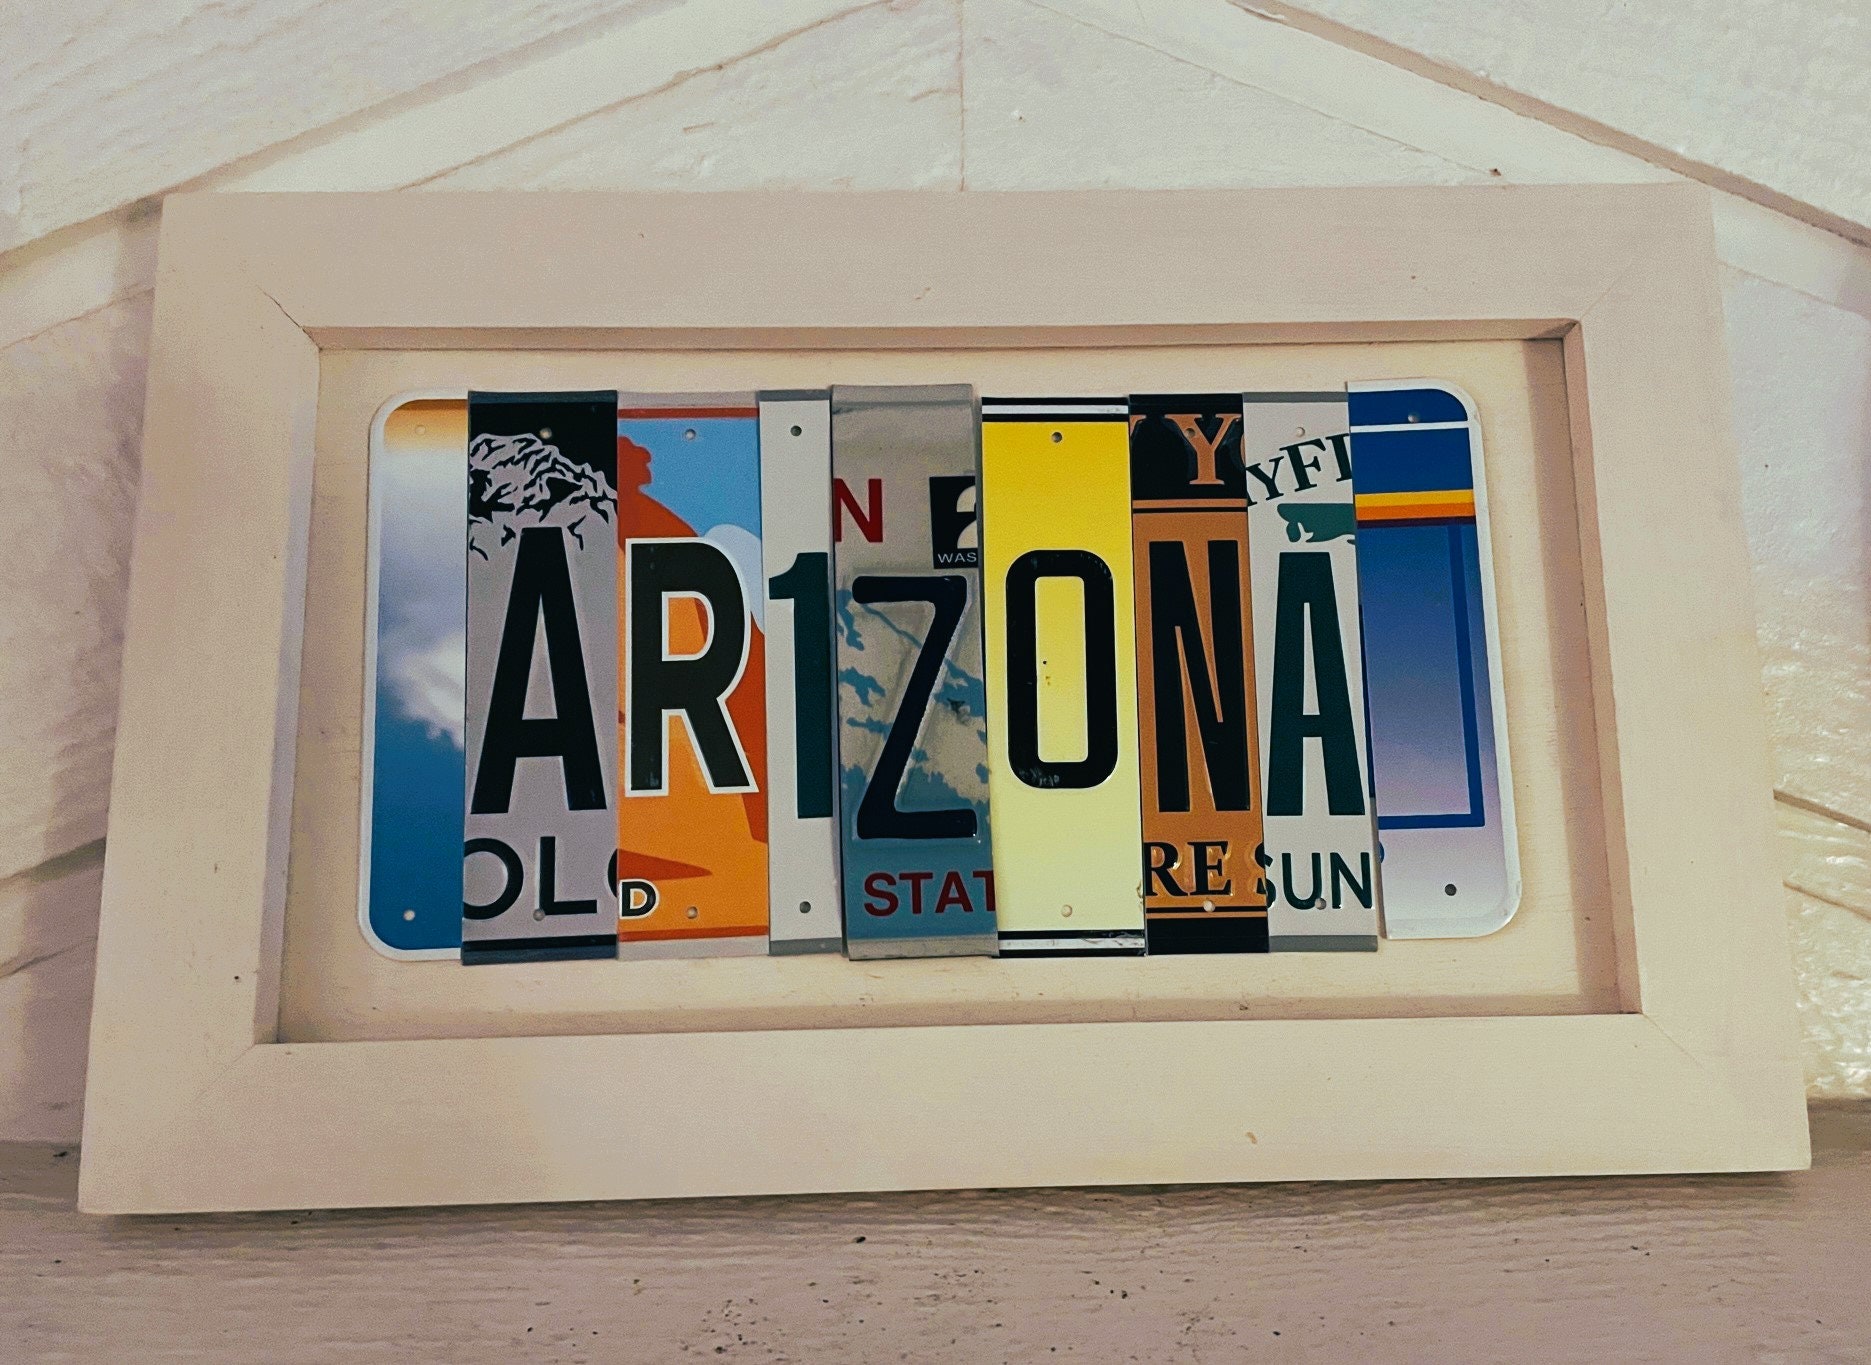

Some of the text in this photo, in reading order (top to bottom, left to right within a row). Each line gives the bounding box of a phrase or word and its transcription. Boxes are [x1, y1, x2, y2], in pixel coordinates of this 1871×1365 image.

[1164, 413, 1245, 485] Y
[937, 551, 978, 564] WAS
[463, 836, 617, 920] OL
[618, 878, 659, 920] D
